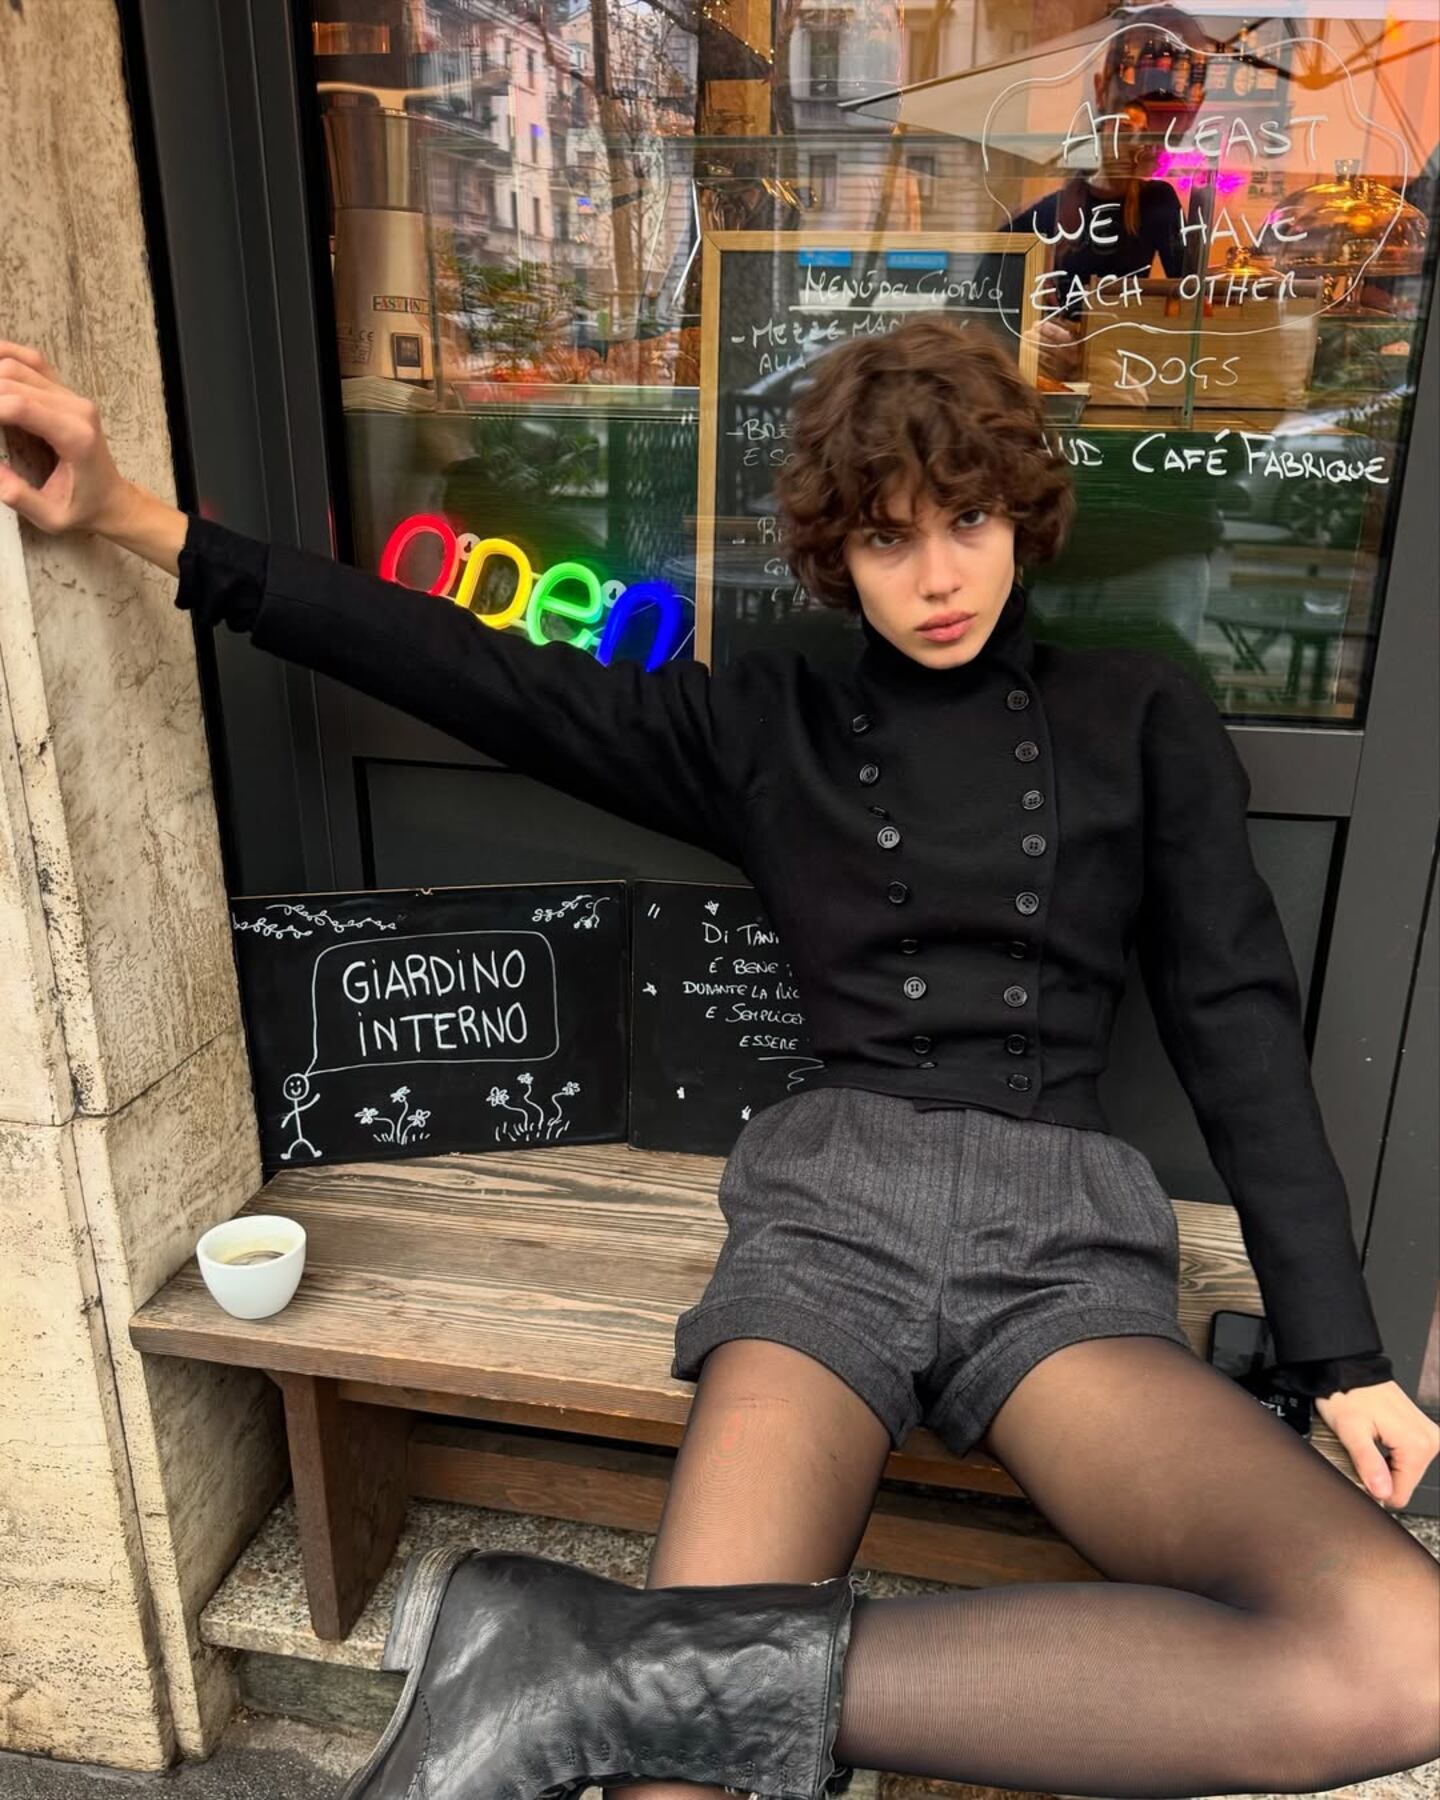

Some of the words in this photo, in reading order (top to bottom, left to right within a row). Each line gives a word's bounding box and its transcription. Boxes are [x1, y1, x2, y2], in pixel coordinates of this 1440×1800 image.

[1062, 101, 1131, 161] AT
[1164, 115, 1328, 160] LEAST
[1032, 203, 1121, 244] WE
[1179, 206, 1308, 248] HAVE
[1030, 270, 1144, 311] EACH
[1179, 271, 1298, 309] OTHER
[1114, 348, 1241, 390] DOGS
[1131, 429, 1232, 476] CAFÉ
[1239, 430, 1390, 484] FABRIQUE
[736, 923, 780, 946] TAN
[732, 958, 779, 975] BENE
[751, 985, 768, 1000] LA
[704, 1005, 718, 1019] E
[738, 1034, 799, 1051] ESSERE
